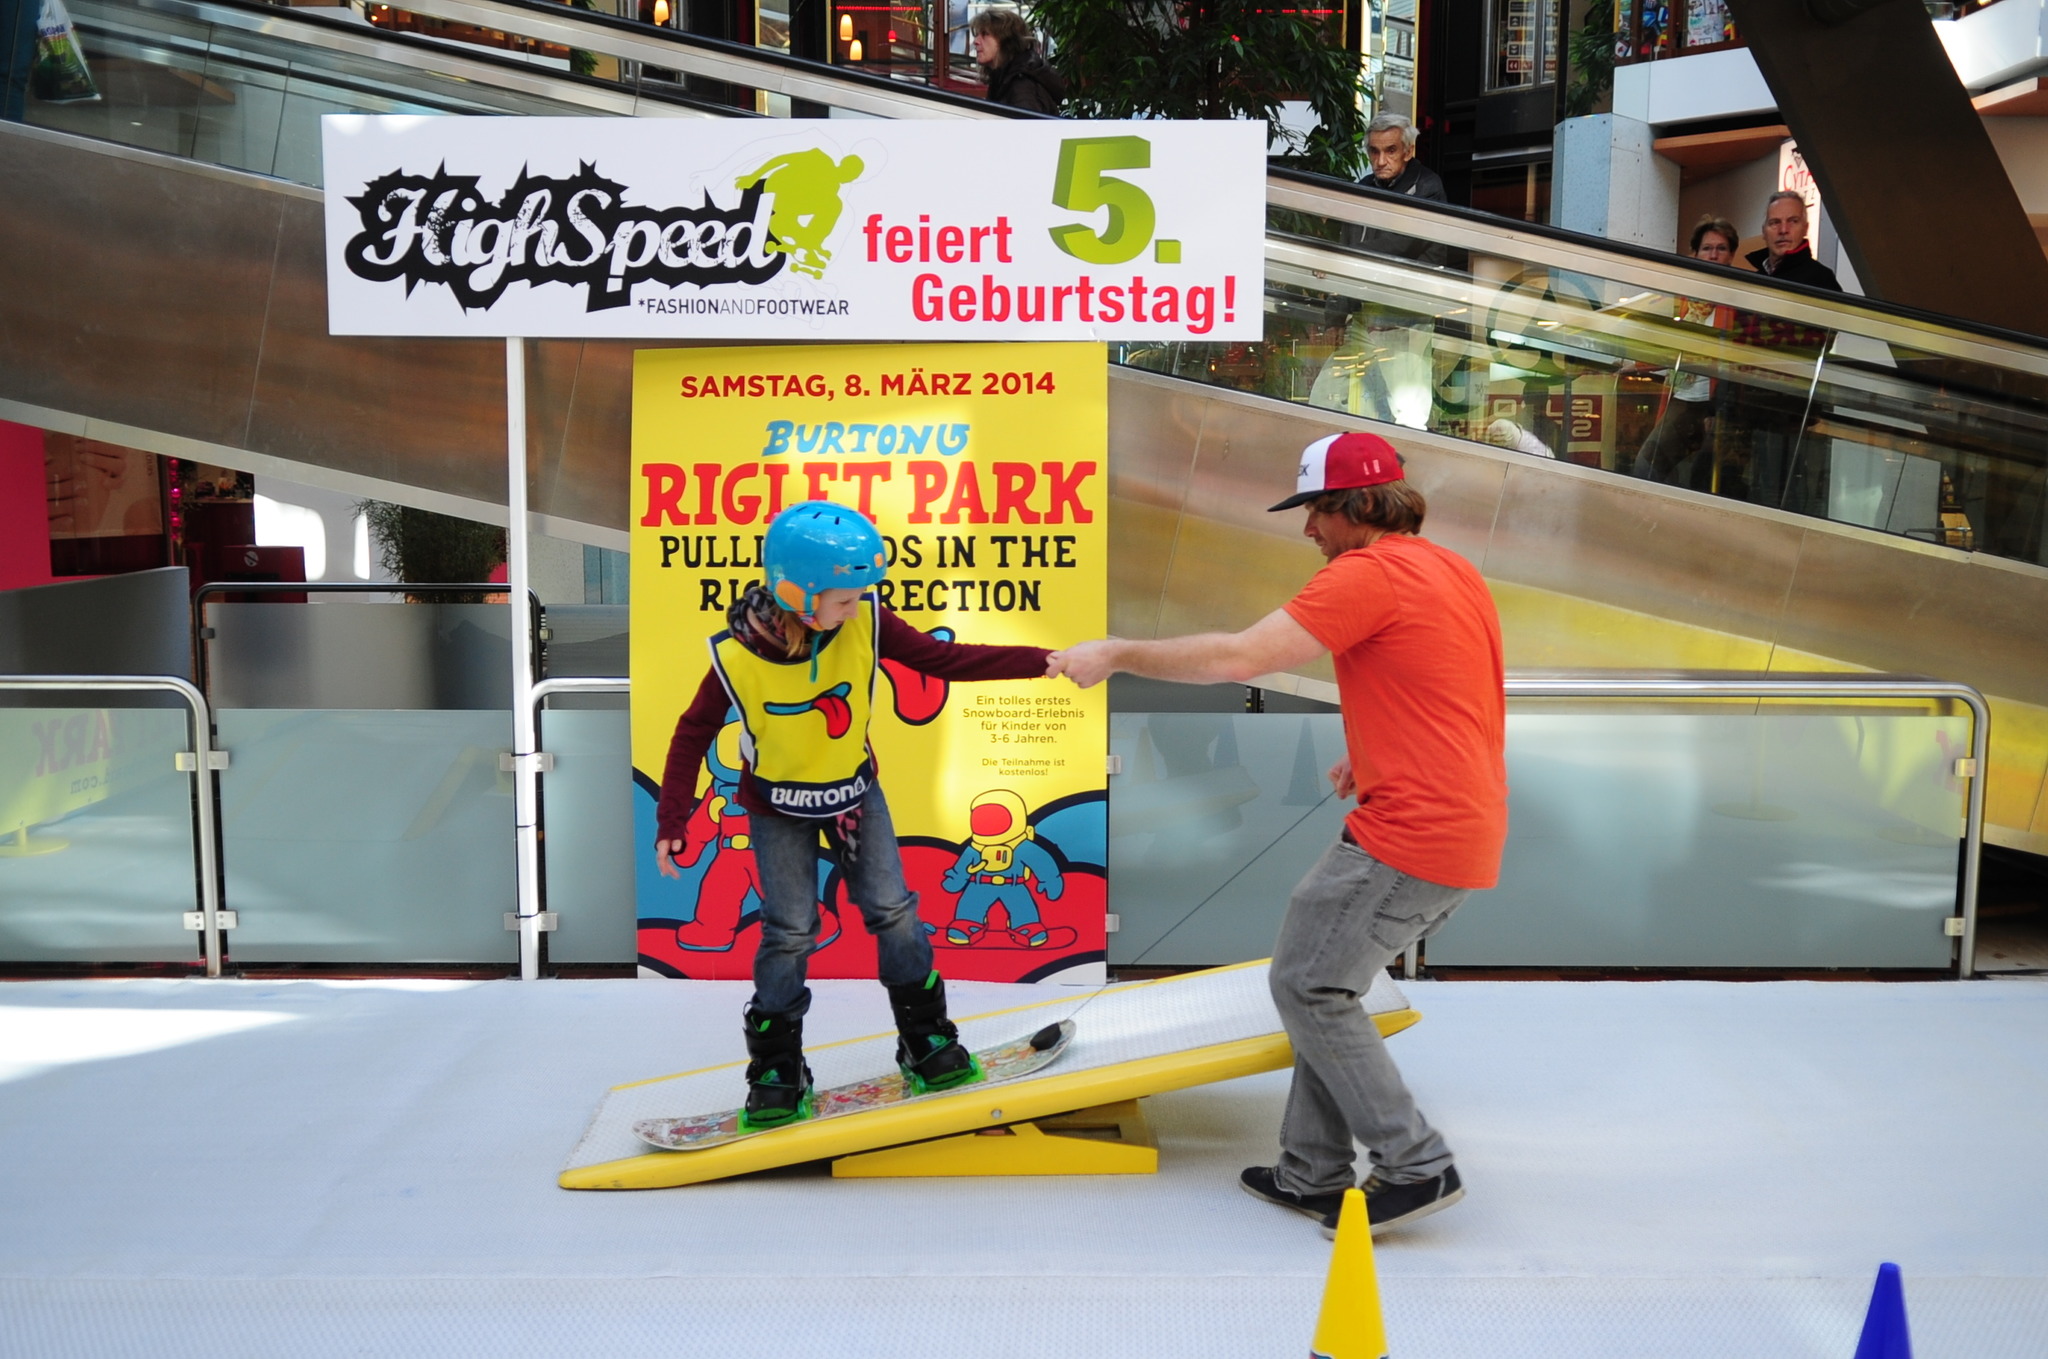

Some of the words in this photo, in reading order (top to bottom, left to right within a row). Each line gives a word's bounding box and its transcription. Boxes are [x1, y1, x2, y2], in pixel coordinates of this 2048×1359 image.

[862, 213, 1013, 264] feiert
[1047, 135, 1182, 265] 5.
[361, 188, 781, 293] HighSpeed
[911, 272, 1236, 335] Geburtstag!
[680, 374, 835, 401] SAMSTAG,
[844, 373, 871, 397] 8.
[880, 368, 972, 396] MÄRZ
[981, 371, 1055, 395] 2014
[907, 461, 1097, 525] PARK
[659, 535, 765, 568] PULLI
[936, 535, 976, 568] IN
[991, 535, 1077, 568] THE
[875, 579, 1041, 611] RECTION
[962, 708, 1085, 718] Snowboard-Erlebnis
[976, 695, 995, 705] Ein
[999, 695, 1031, 705] tolles
[1035, 696, 1071, 705] erstes
[981, 721, 997, 731] für
[1001, 721, 1041, 731] Kinder
[1045, 723, 1066, 731] von
[990, 734, 1010, 743] 3-6
[1013, 734, 1057, 744] Jahren.
[981, 758, 998, 766] Die
[1002, 758, 1051, 767] Teilnahme
[1054, 758, 1065, 767] ist
[999, 768, 1048, 776] kostenlos!
[770, 785, 855, 808] BURTON
